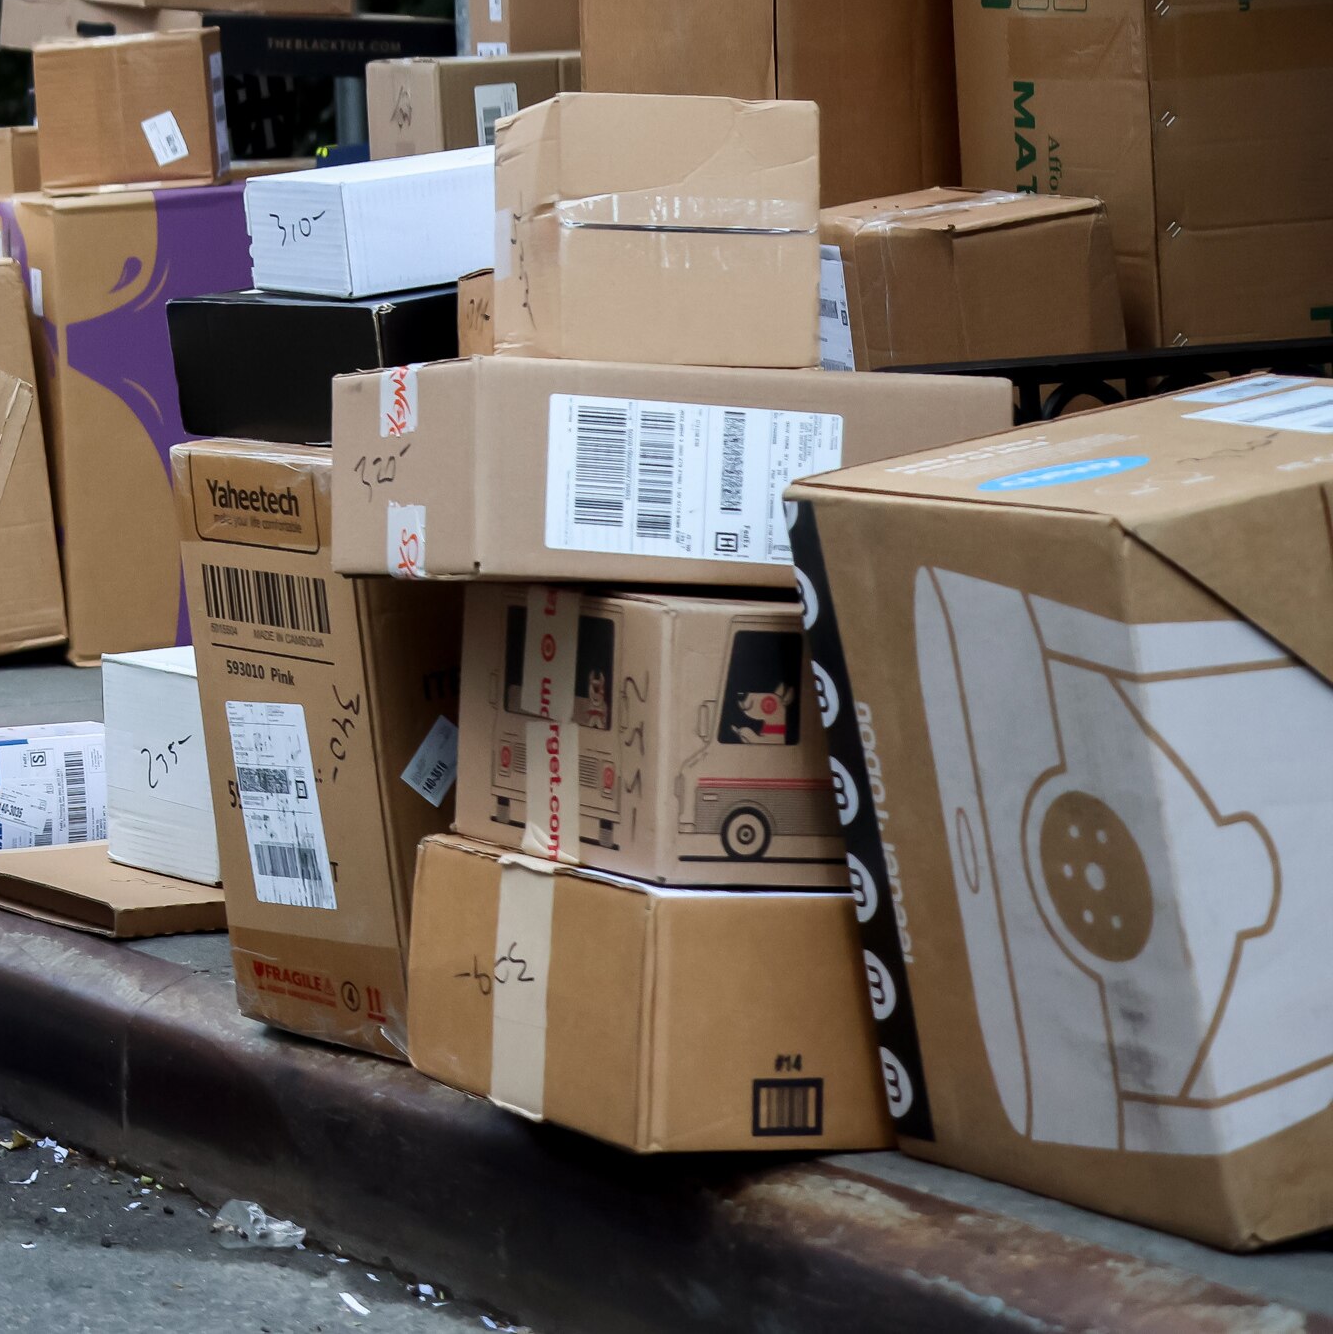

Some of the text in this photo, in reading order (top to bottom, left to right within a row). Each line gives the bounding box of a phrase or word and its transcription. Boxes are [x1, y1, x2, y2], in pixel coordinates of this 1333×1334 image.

[206, 478, 300, 517] Yaheetech
[284, 633, 325, 648] CAMBODIA
[226, 658, 295, 686] 593010 Pink
[264, 964, 322, 992] FRAGILE
[774, 1054, 803, 1072] #14
